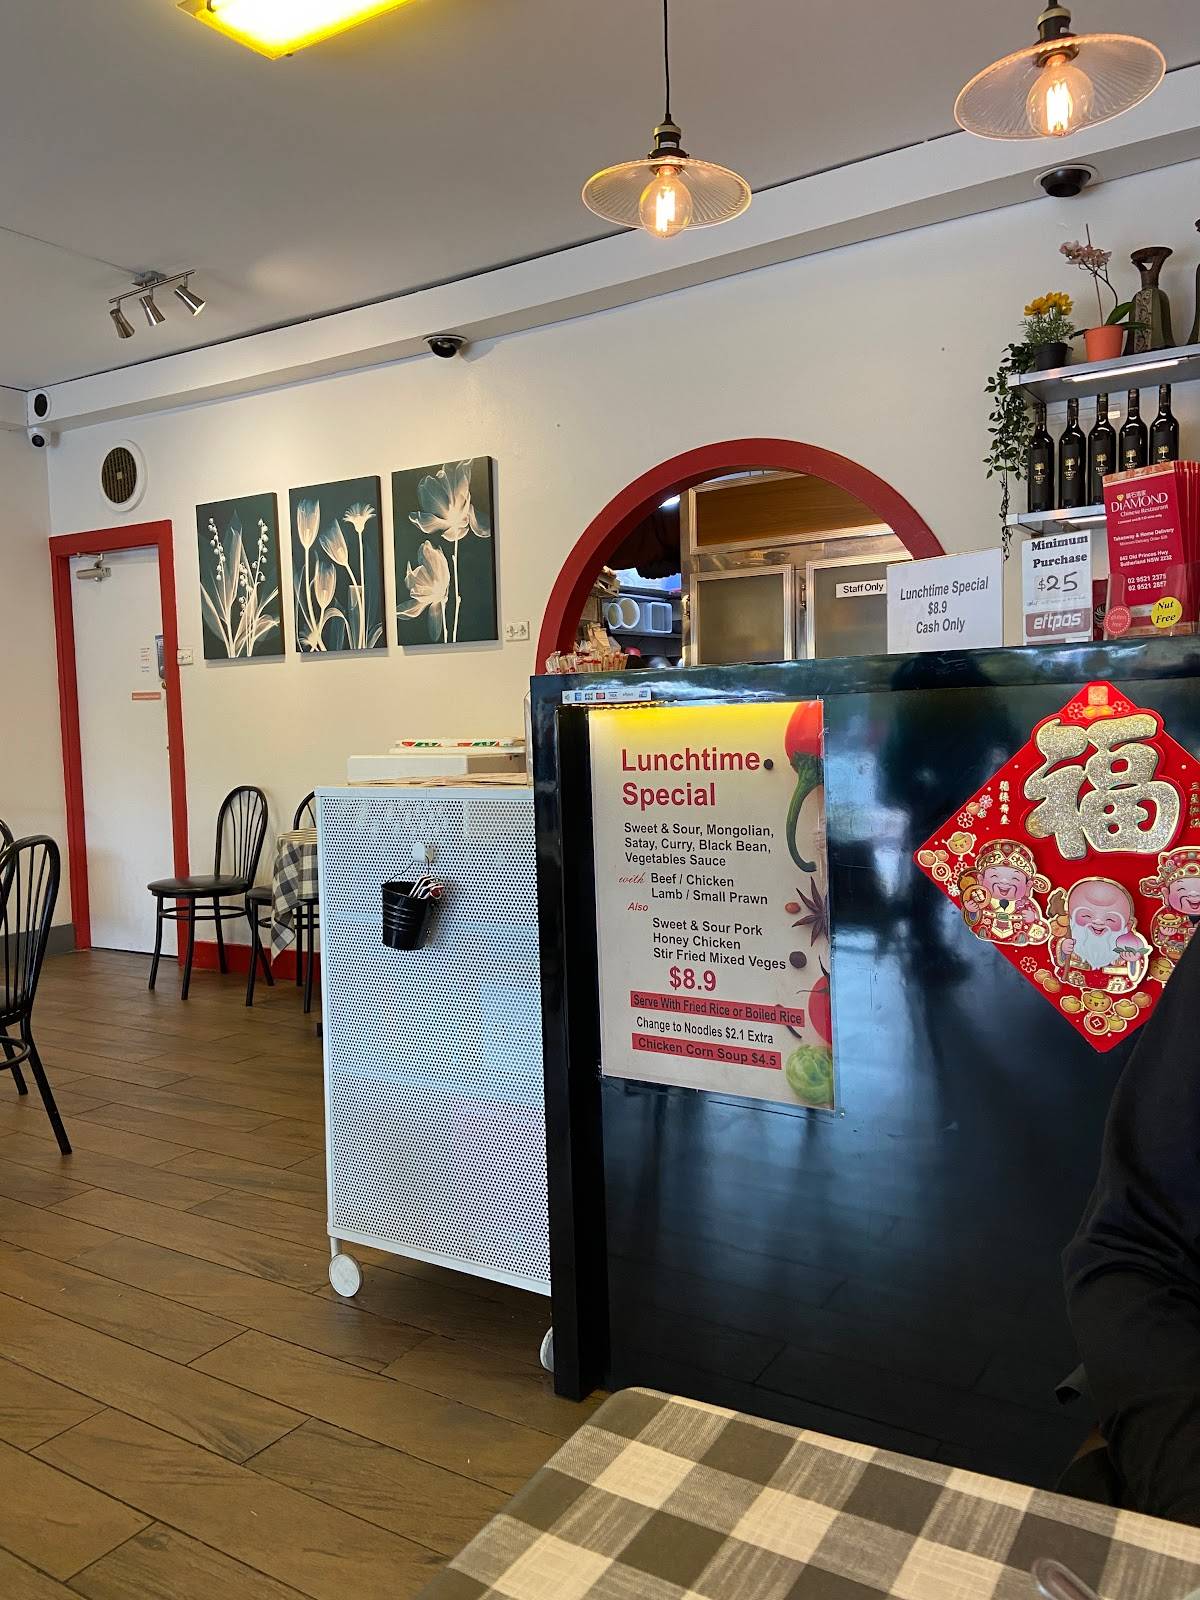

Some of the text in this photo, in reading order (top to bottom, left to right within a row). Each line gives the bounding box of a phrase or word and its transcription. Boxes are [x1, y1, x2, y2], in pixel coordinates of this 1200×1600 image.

[1032, 535, 1088, 551] Minimum
[1033, 553, 1087, 568] Purchase
[843, 582, 884, 594] Staff Only
[900, 576, 989, 601] Lunchtime Special
[1038, 571, 1078, 592] $25
[928, 601, 947, 615] $8.9
[1158, 601, 1174, 610] Nut
[916, 617, 966, 634] Cash Only
[1034, 612, 1081, 631] eftpos
[1156, 614, 1176, 623] Free
[622, 747, 760, 771] Lunchtime
[1024, 714, 1180, 860] 福
[623, 782, 716, 811] Special
[624, 823, 774, 838] Sweet & Sour, Mongolian,
[625, 838, 771, 854] Satay, Curry, Black Bean,
[625, 852, 726, 866] Vegetables Sauce
[618, 872, 645, 884] with
[651, 873, 676, 884] Beef
[686, 875, 734, 887] Chicken
[652, 888, 682, 899] Lamb
[693, 890, 726, 902] Small
[729, 892, 768, 905] Prawn
[627, 902, 649, 912] Also
[652, 918, 763, 936] Sweet & Sour Pork
[653, 933, 741, 949] Honey Chicken
[653, 948, 786, 970] Stir Fried Mixed Veges
[669, 966, 716, 991] $8.9
[634, 994, 801, 1024] Serve With Fried Rice or Boiled Rice
[636, 1016, 774, 1044] Change to Noodles $2.1 Extra
[638, 1037, 776, 1066] Chicken Corn Soup $4.5
